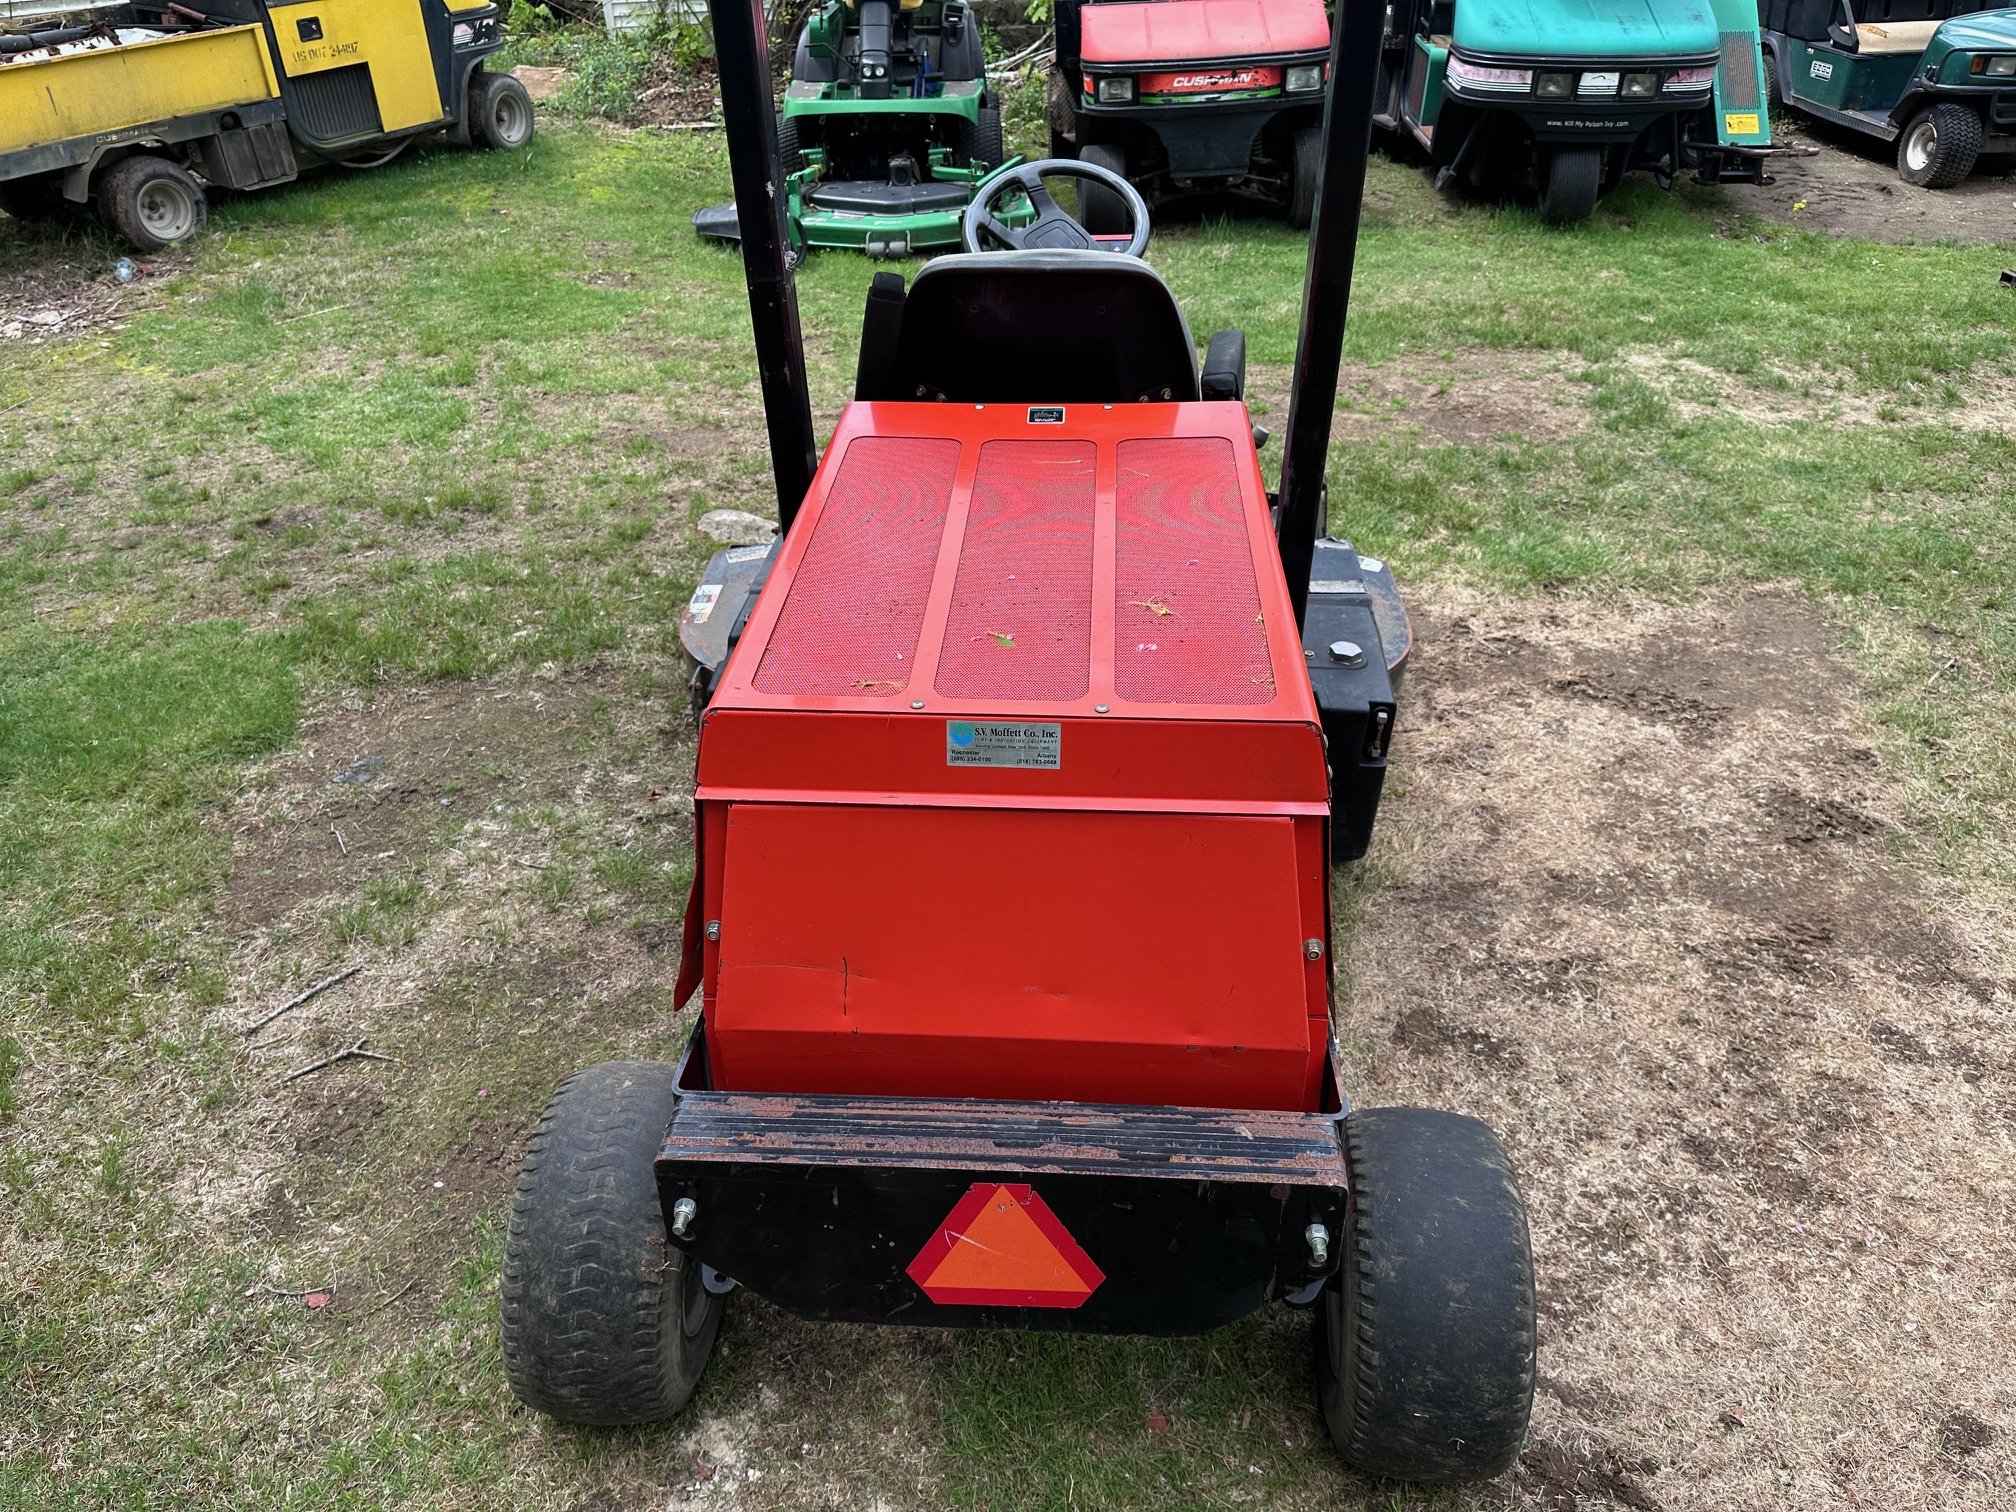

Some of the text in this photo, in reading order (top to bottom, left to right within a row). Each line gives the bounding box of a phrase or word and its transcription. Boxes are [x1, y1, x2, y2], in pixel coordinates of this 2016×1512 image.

[990, 728, 1021, 737] Moffett
[1023, 729, 1039, 738] Co.,
[1042, 729, 1058, 738] Inc.
